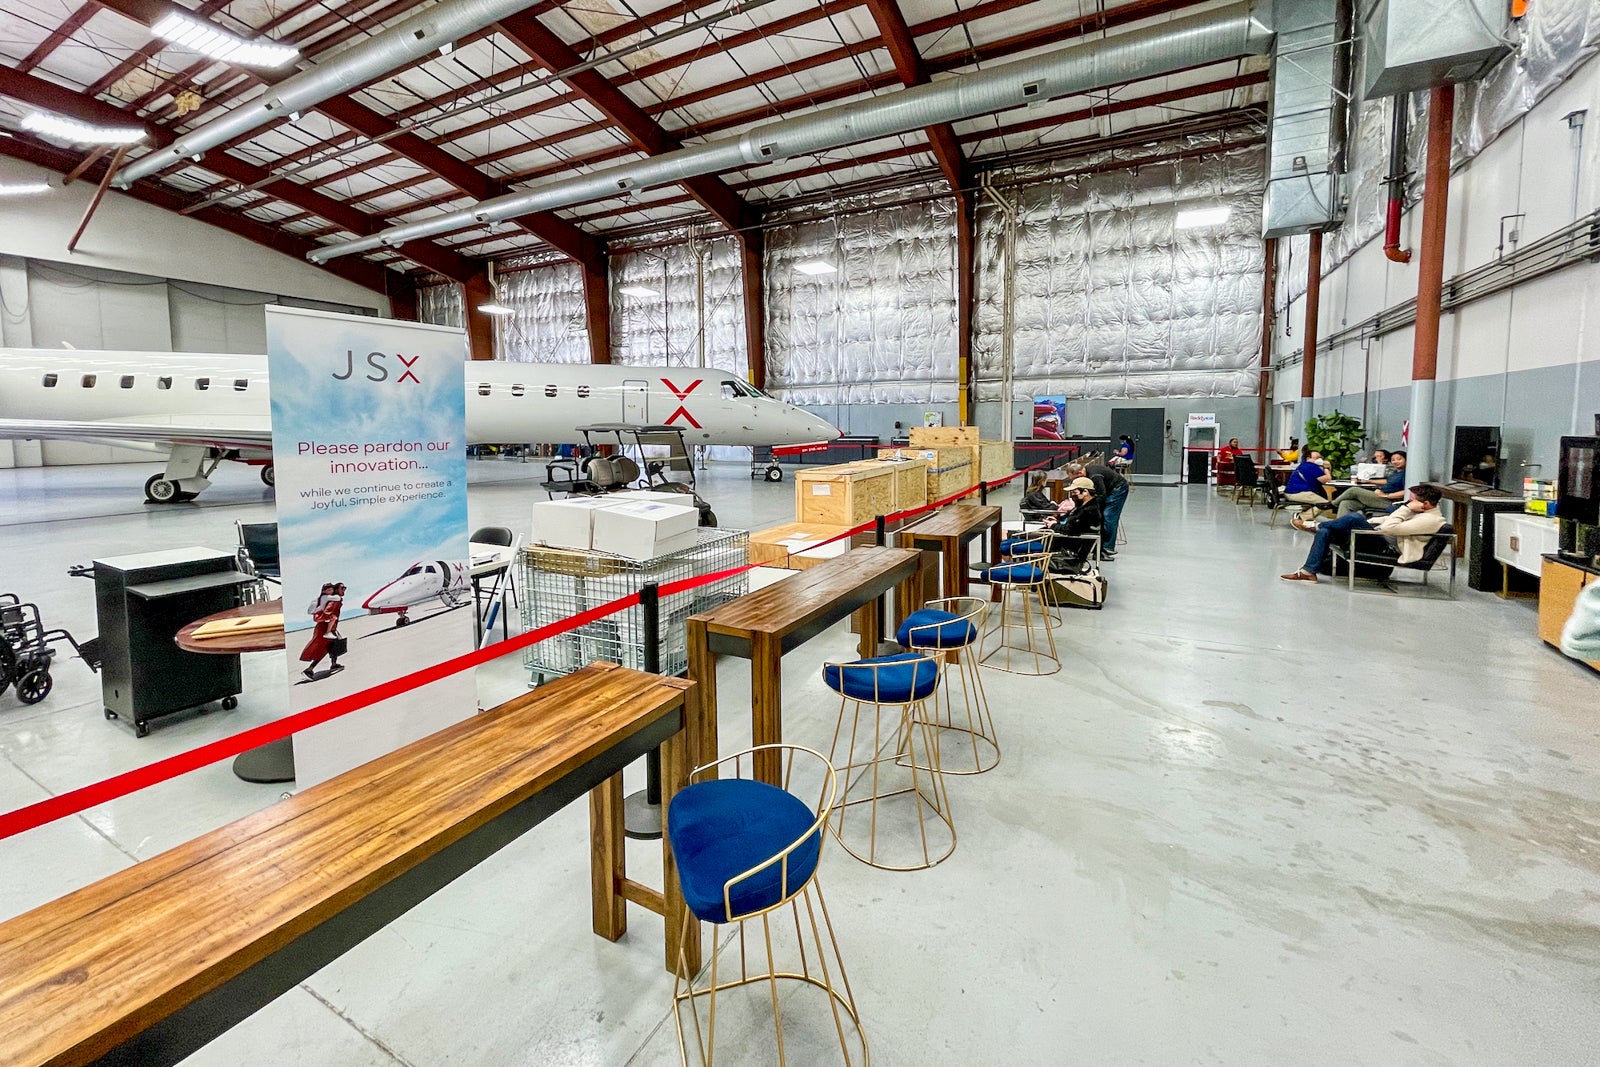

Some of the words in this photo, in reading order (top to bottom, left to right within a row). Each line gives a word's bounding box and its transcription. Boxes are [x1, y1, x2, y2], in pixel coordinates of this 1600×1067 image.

[332, 350, 420, 384] JSX
[298, 440, 359, 455] Please
[364, 439, 423, 456] pardon
[426, 440, 450, 451] our
[330, 457, 428, 474] innovation...
[300, 487, 332, 498] while
[334, 487, 351, 496] we
[353, 483, 401, 494] continue
[403, 481, 413, 490] to
[415, 480, 445, 490] create
[349, 494, 386, 507] Simple
[388, 490, 446, 503] eXperience.
